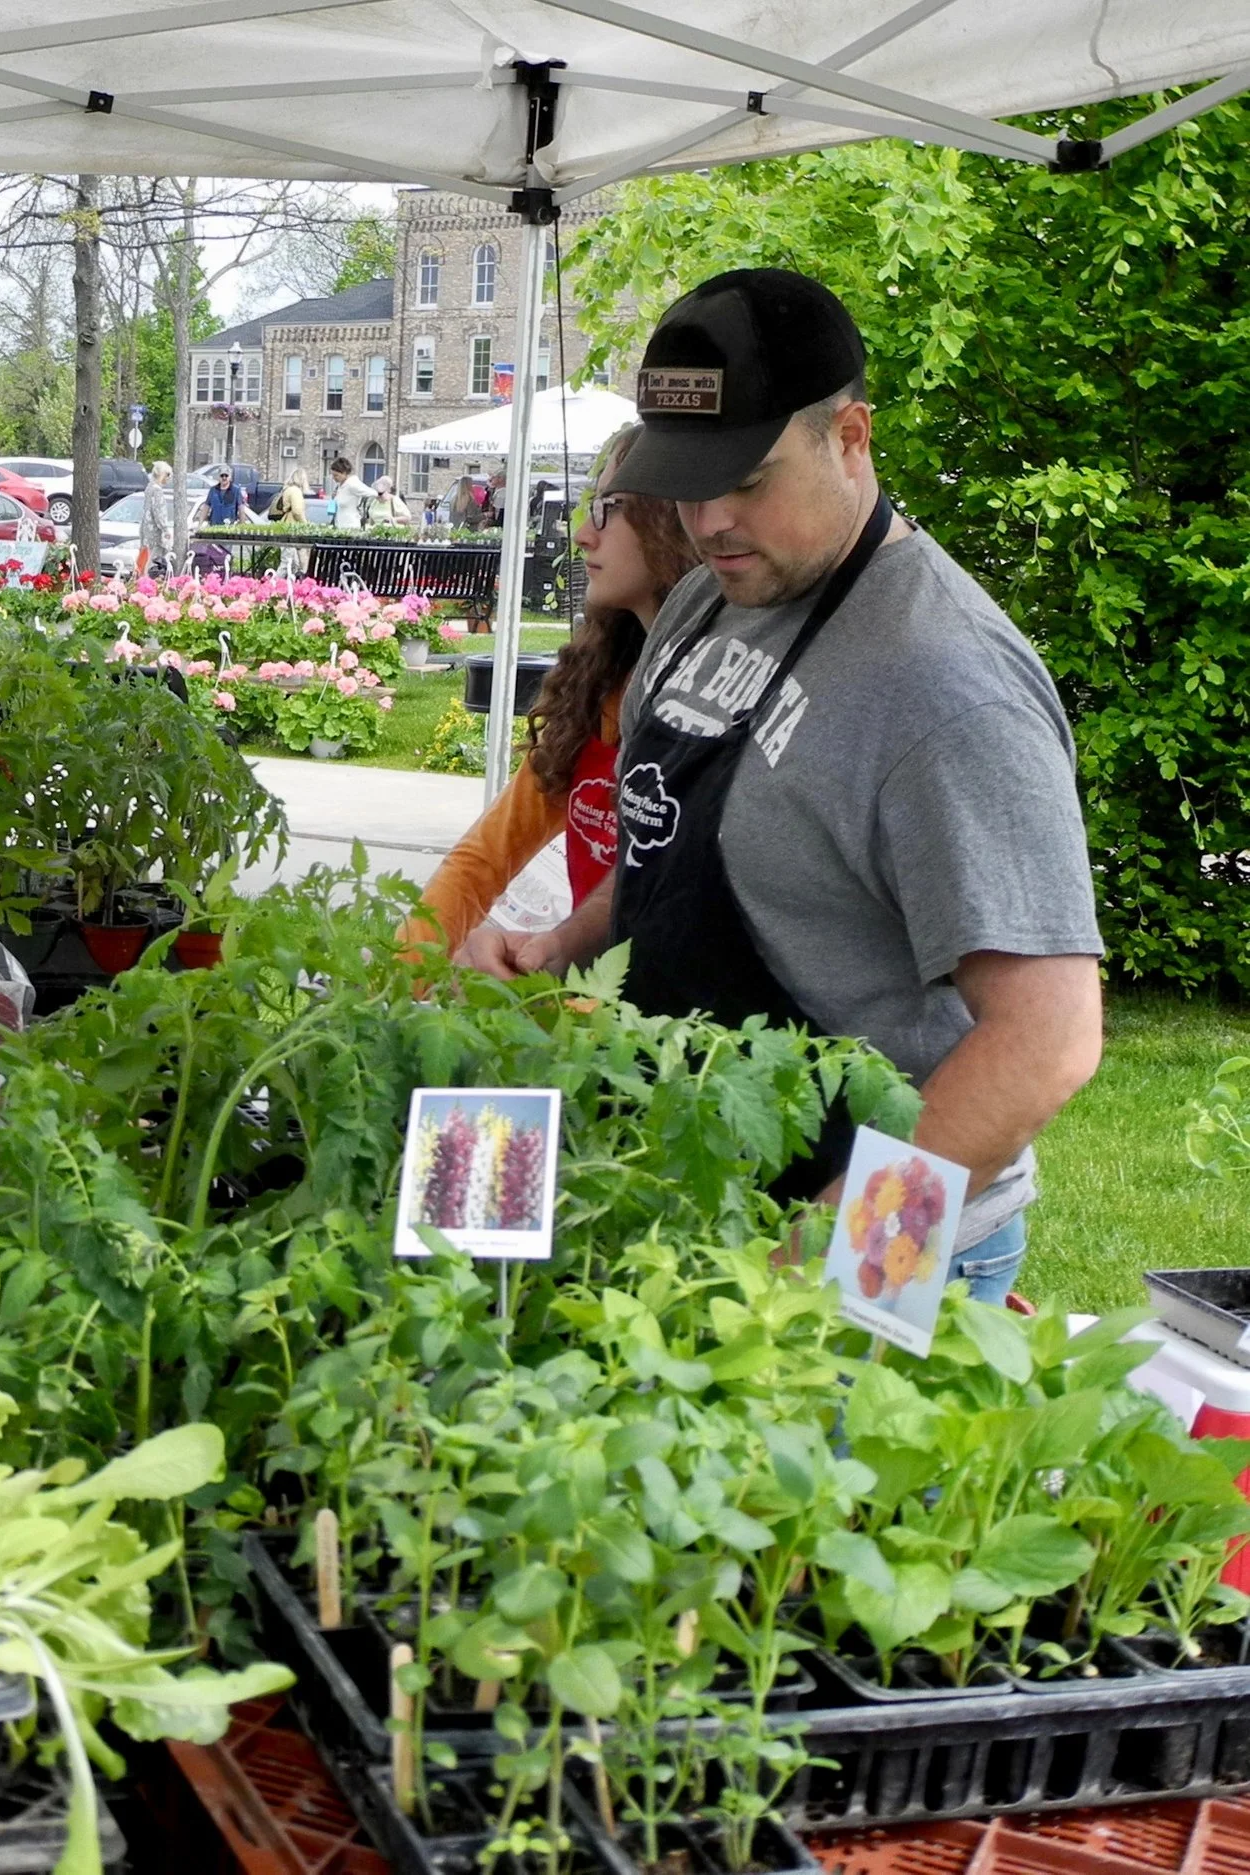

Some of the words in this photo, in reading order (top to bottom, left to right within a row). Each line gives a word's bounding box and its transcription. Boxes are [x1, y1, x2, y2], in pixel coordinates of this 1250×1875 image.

[656, 393, 701, 406] TEXAS
[422, 440, 500, 451] HILLSVIEW
[530, 441, 569, 451] ARMS
